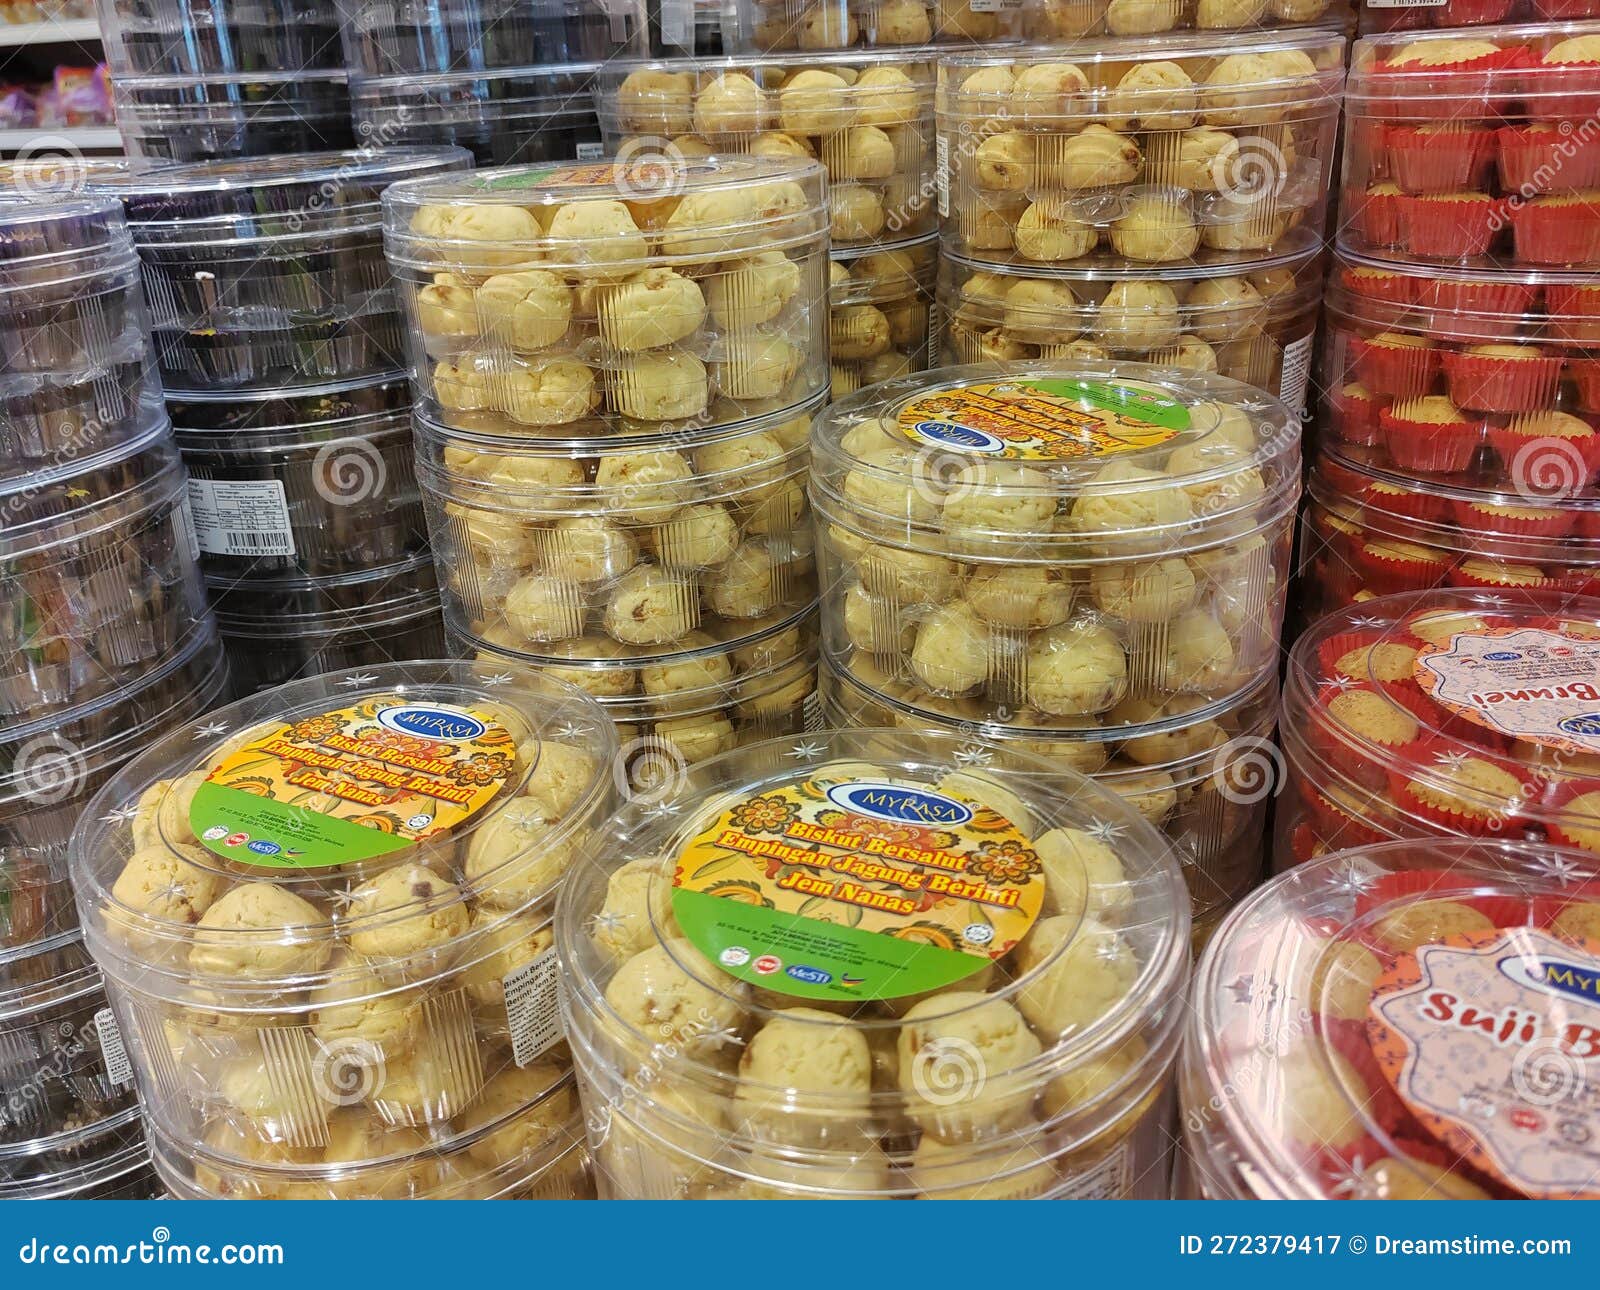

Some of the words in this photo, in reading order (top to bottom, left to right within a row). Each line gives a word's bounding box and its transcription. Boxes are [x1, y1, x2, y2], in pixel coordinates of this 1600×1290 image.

[1471, 682, 1600, 710] Brunei
[402, 710, 473, 739] MYRASA
[265, 739, 345, 771] Empingan
[342, 760, 408, 788] Jagung
[406, 775, 477, 804] Berinti
[325, 734, 380, 758] Biskut
[379, 747, 453, 776] Bersalut
[291, 771, 331, 792] Jem
[332, 780, 387, 806] Nanas
[863, 790, 957, 823] MYRASA
[786, 821, 863, 850] Biskut
[864, 837, 970, 872] Bersalut
[718, 830, 834, 868] Empingan
[832, 855, 927, 890] Jagung
[928, 876, 1021, 908] Berinti
[779, 871, 833, 898] Jem
[837, 883, 917, 915] Nanas
[503, 970, 529, 989] Biskut
[1549, 965, 1600, 996] MY
[1424, 992, 1536, 1043] Suji
